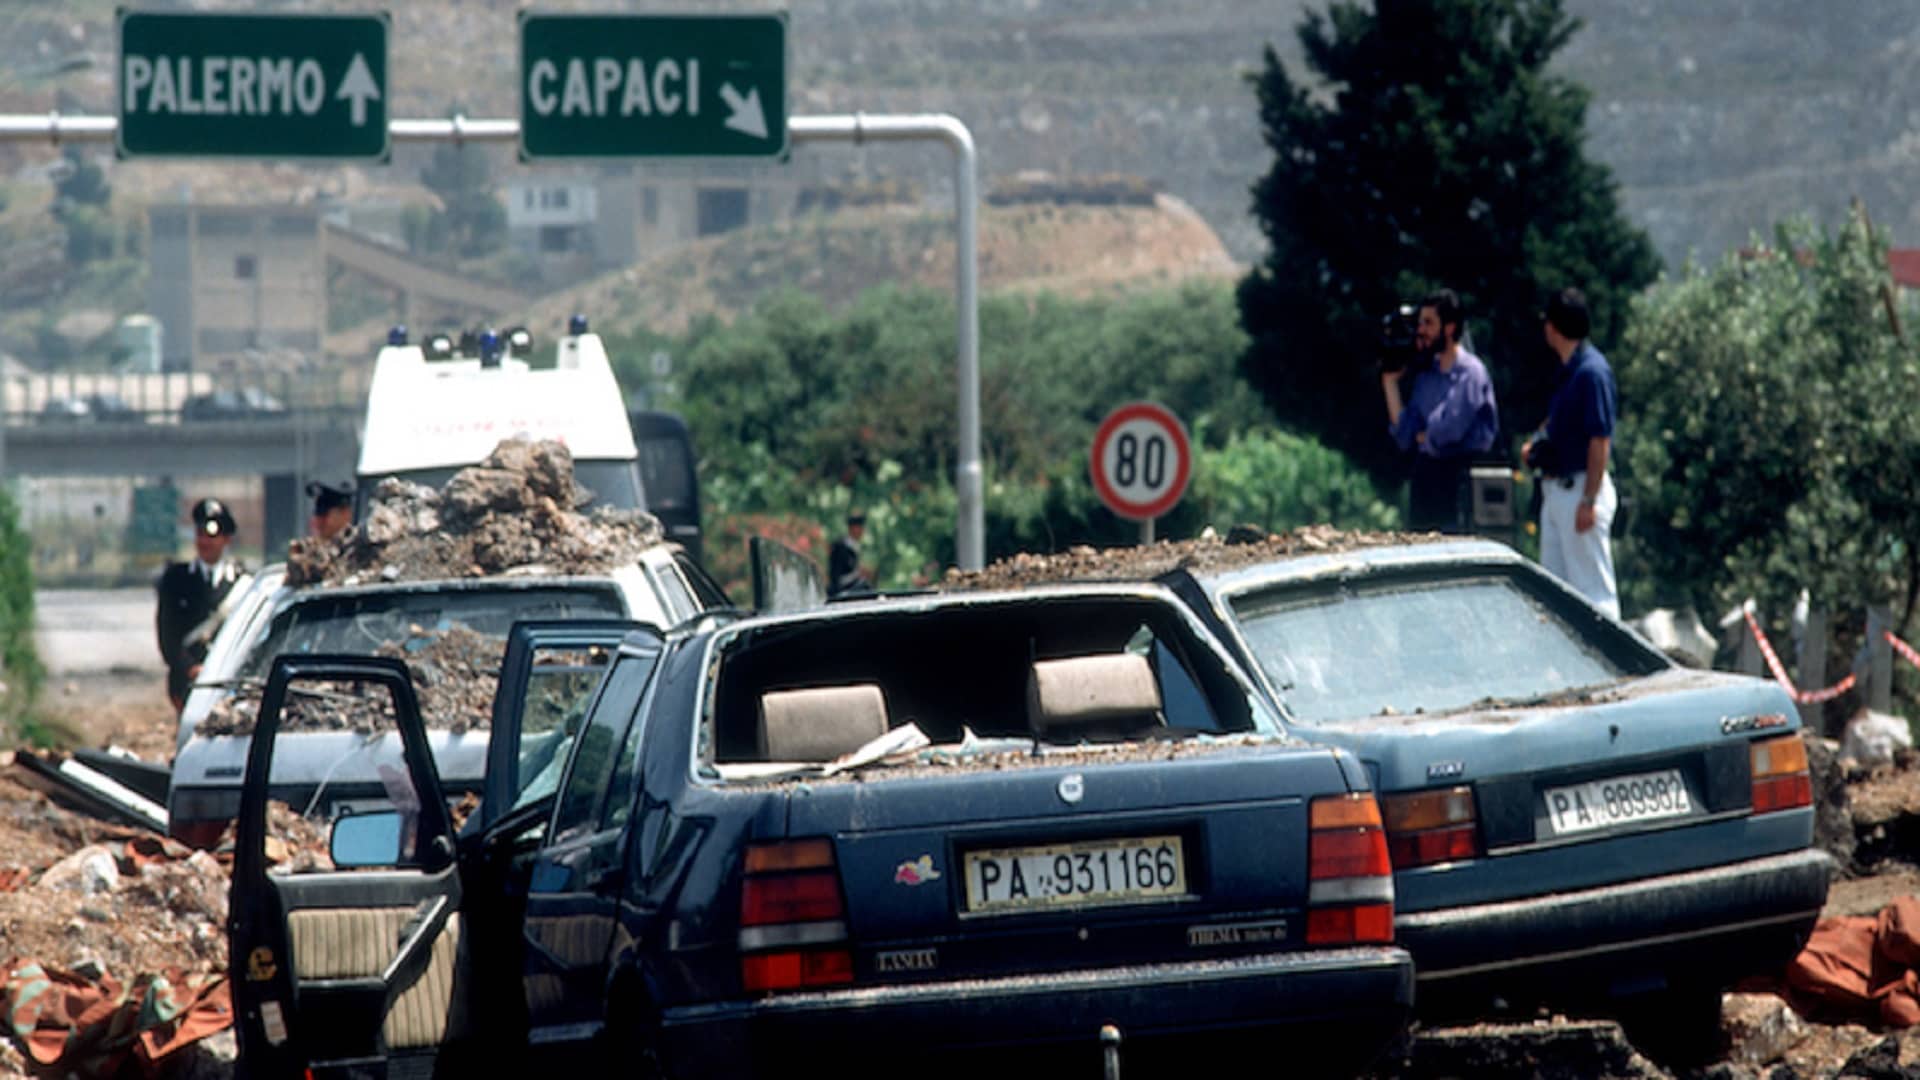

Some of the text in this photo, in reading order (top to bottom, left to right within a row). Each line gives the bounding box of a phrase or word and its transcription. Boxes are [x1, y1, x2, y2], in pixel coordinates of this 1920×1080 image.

[125, 57, 325, 114] PALERMO
[528, 58, 699, 116] CAPACI
[1116, 433, 1165, 489] 80
[1551, 790, 1592, 828] PA
[980, 858, 1029, 901] PA
[1053, 847, 1176, 896] 931166
